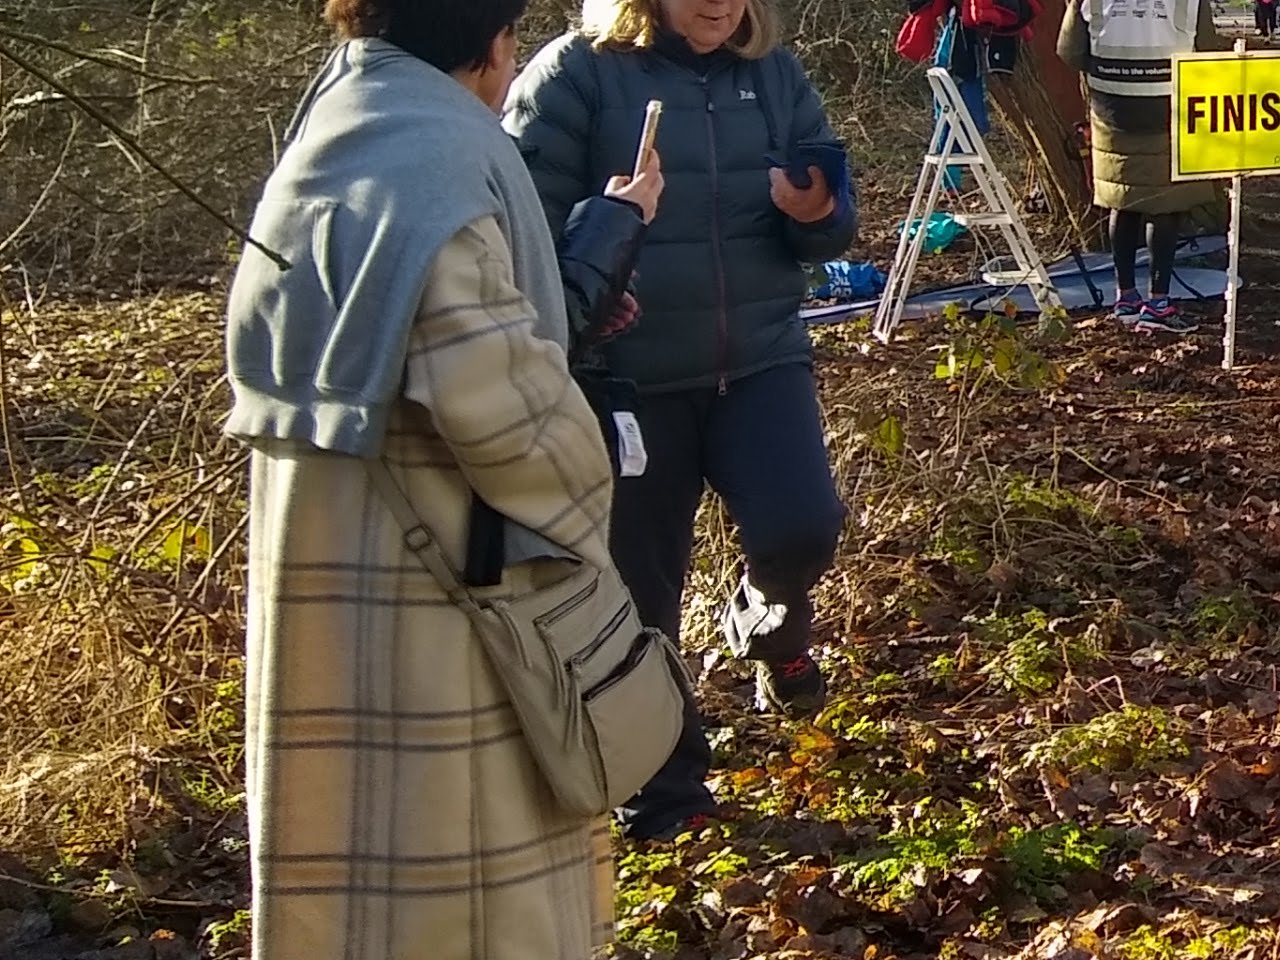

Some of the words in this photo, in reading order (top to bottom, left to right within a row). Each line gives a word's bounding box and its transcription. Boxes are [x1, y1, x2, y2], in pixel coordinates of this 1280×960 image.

[1097, 65, 1121, 74] Thanks
[1121, 67, 1130, 75] to
[1130, 67, 1144, 75] the
